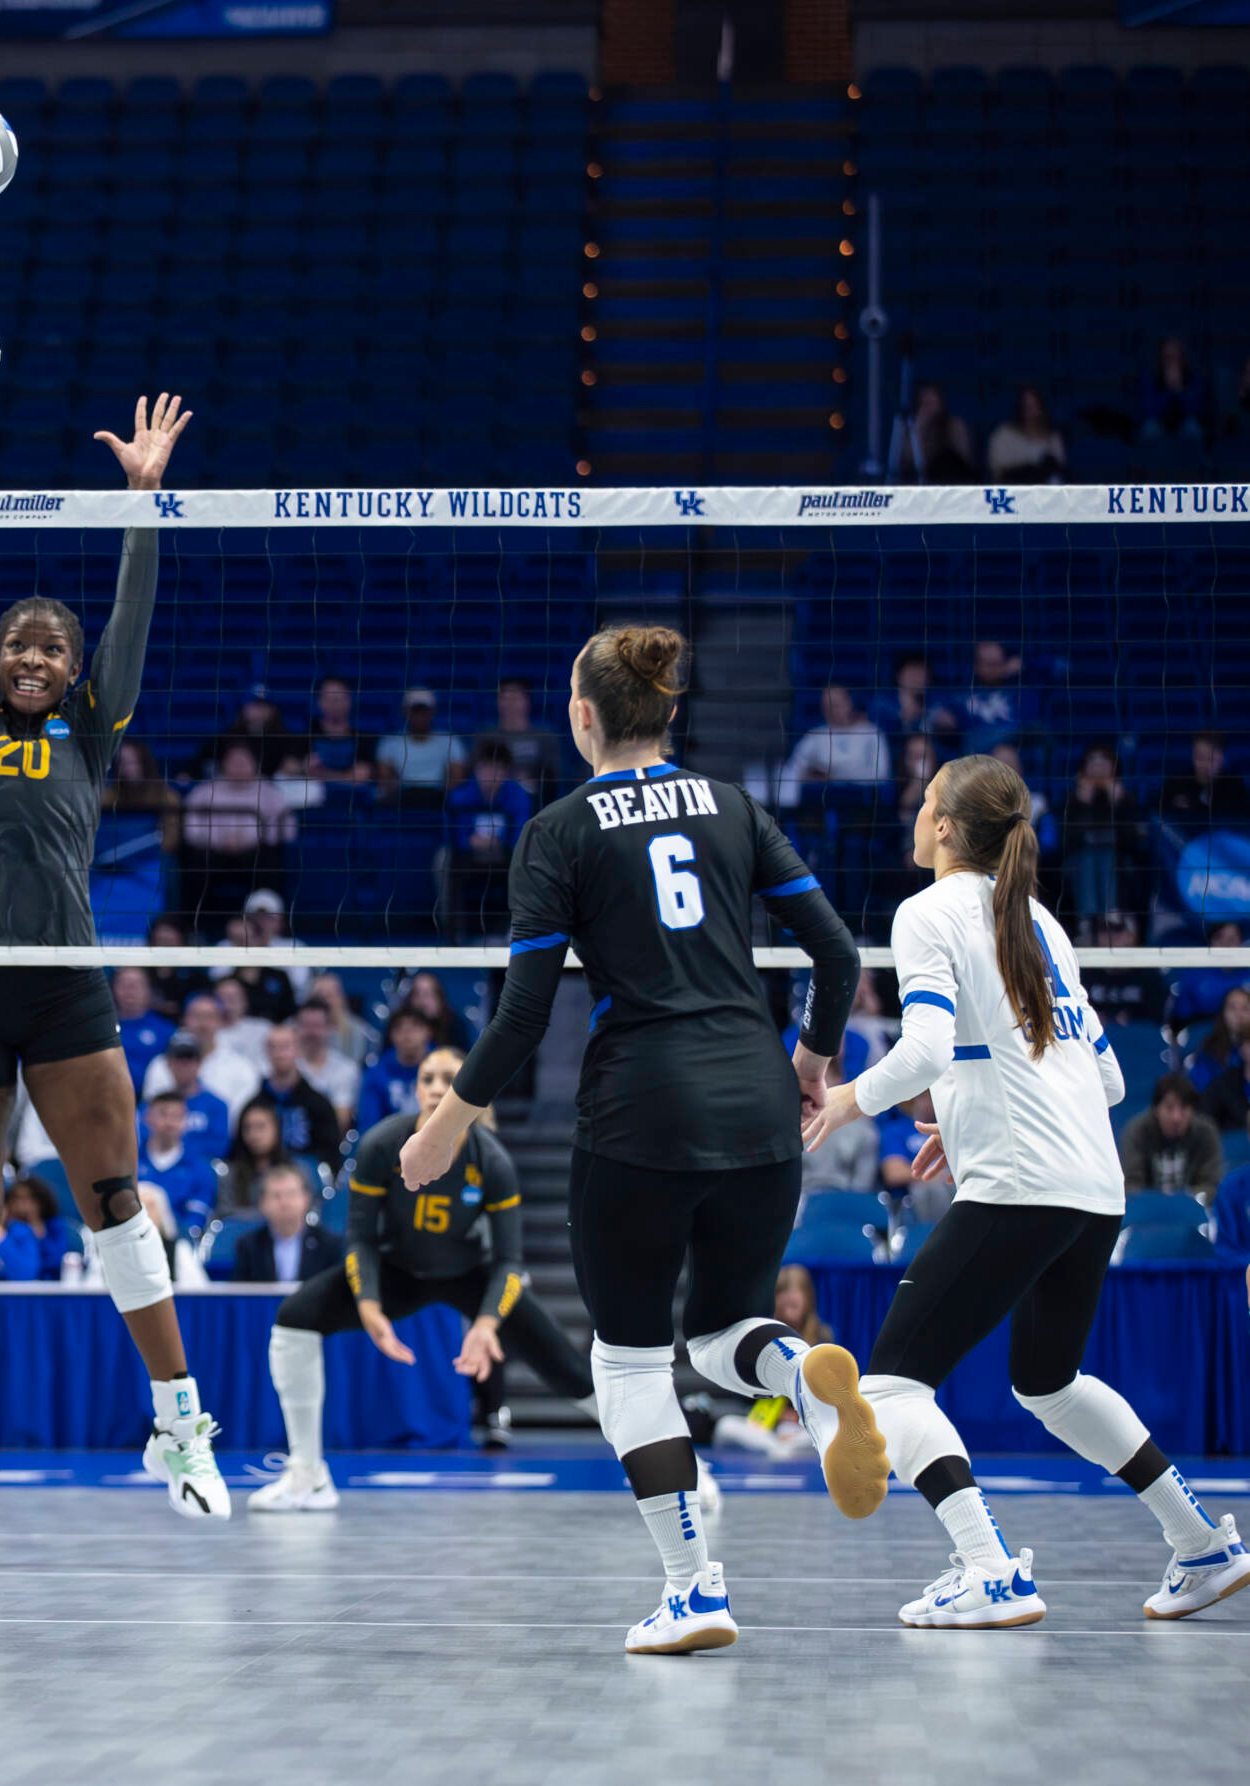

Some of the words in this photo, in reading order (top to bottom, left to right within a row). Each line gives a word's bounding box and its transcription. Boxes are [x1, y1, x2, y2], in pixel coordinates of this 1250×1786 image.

[154, 494, 183, 518] UK
[275, 492, 433, 517] KENTUCKY
[448, 492, 580, 518] WILDCATS
[675, 491, 705, 516] UK
[984, 489, 1015, 514] UK
[586, 779, 718, 830] BEAVIN
[646, 832, 706, 931] 6
[414, 1194, 452, 1234] 15
[983, 1580, 1012, 1604] UK
[668, 1595, 689, 1620] UK
